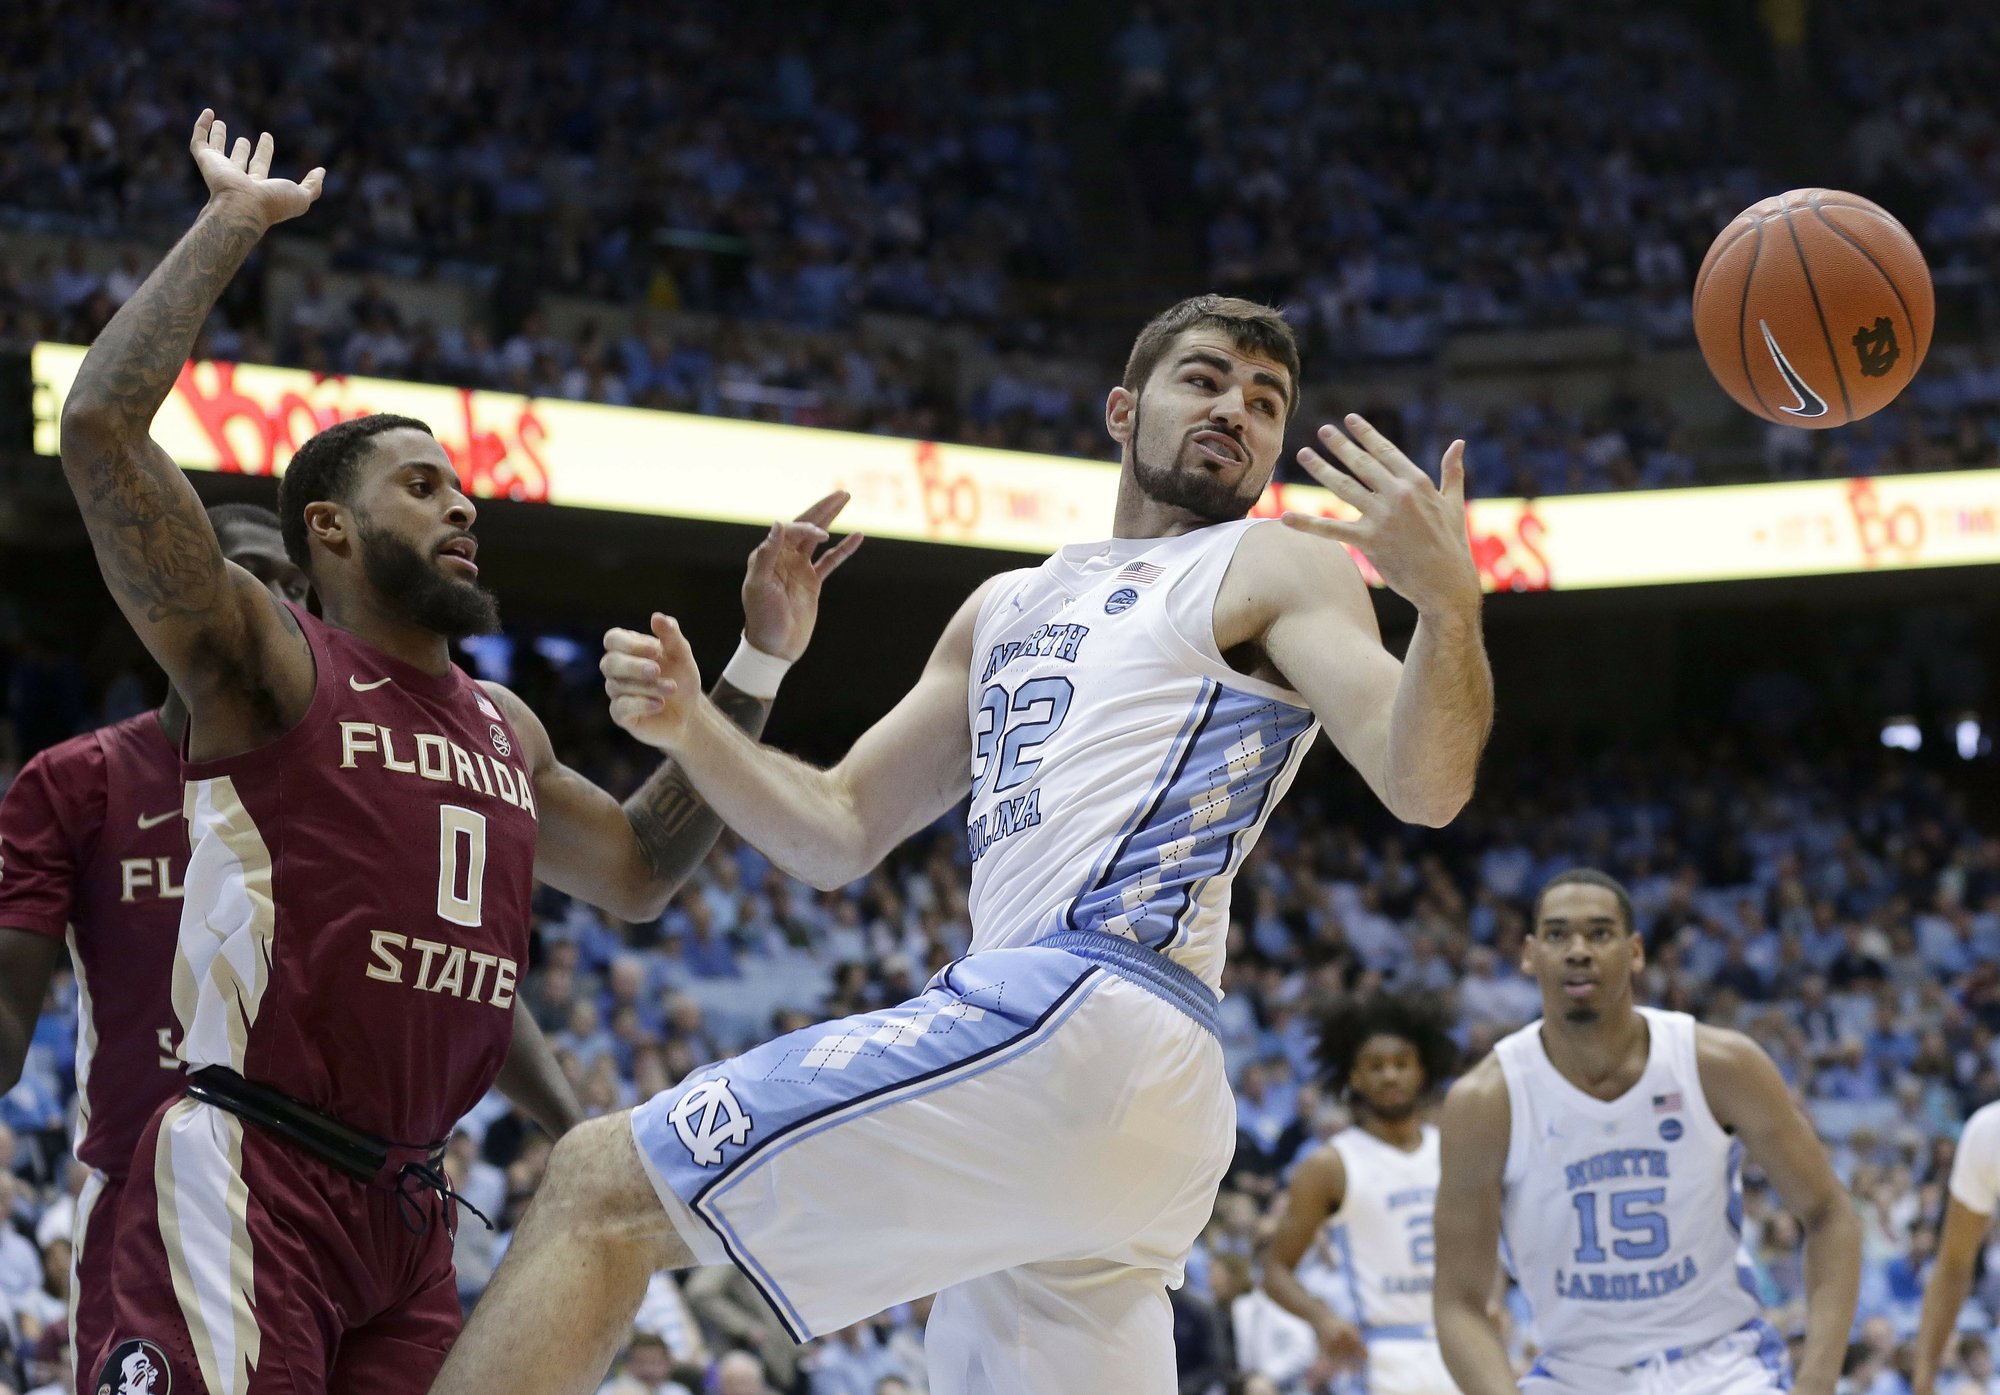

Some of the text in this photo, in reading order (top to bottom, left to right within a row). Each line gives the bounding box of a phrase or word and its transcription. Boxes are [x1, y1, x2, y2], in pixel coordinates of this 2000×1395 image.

[981, 623, 1090, 684] NRTH
[339, 721, 537, 820] FLORIDA
[972, 676, 1075, 800] 32
[437, 804, 486, 928] 0
[366, 929, 517, 1009] STATE
[1565, 1148, 1669, 1190] NORTH
[1572, 1187, 1670, 1264] 15
